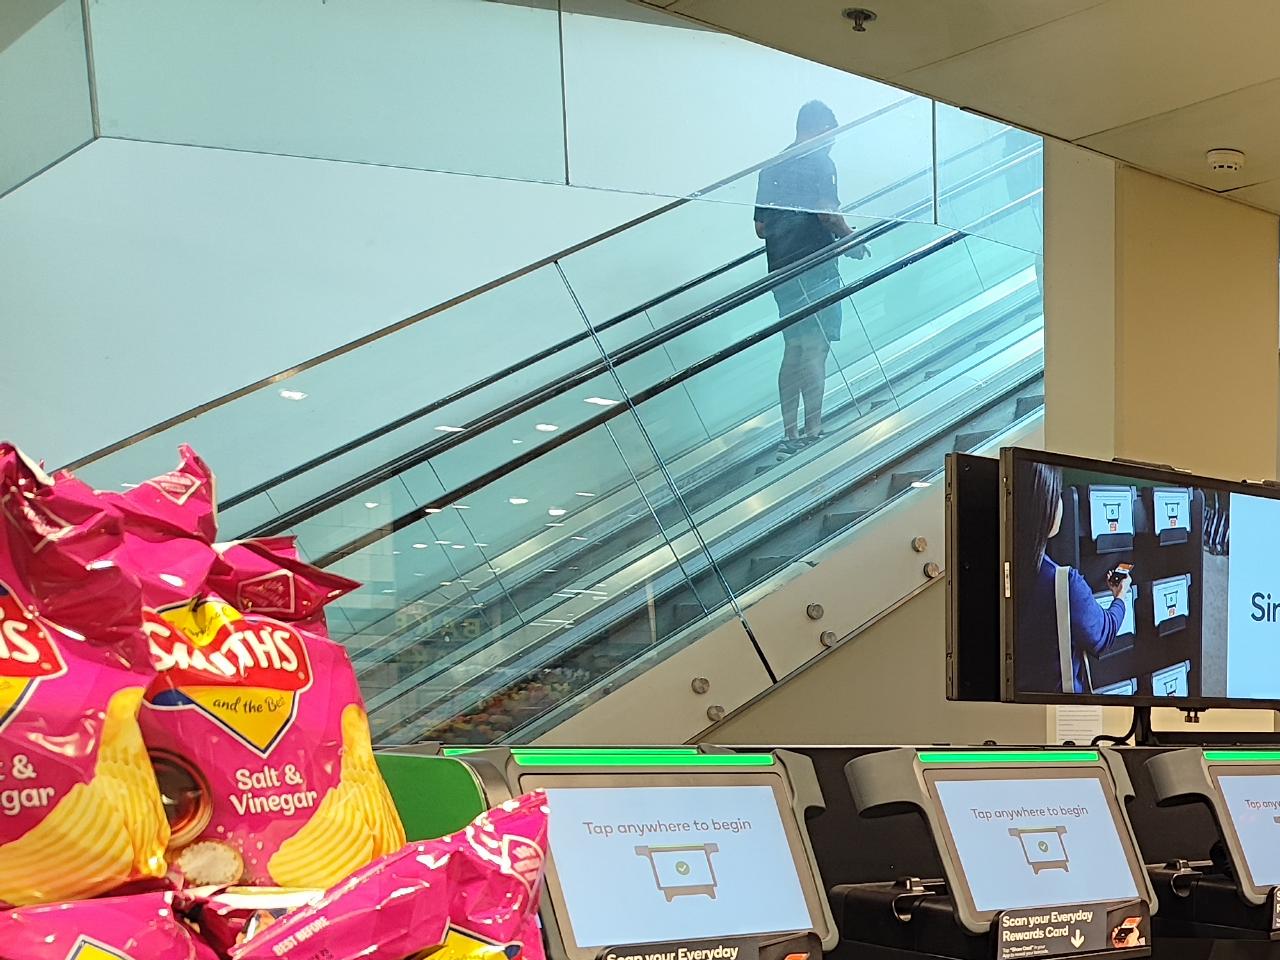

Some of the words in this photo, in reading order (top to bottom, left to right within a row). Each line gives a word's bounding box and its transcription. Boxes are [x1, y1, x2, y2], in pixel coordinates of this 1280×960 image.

[213, 697, 240, 712] and
[244, 699, 263, 714] the
[12, 754, 38, 779] &
[235, 766, 281, 790] Salt
[284, 764, 304, 785] &
[230, 790, 317, 816] Vinegar
[971, 808, 992, 822] Tap
[995, 806, 1046, 821] anywhere
[1046, 807, 1058, 816] to
[1059, 804, 1088, 818] begin
[583, 822, 613, 837] Tap
[617, 818, 690, 837] anywhere
[694, 820, 709, 832] to
[711, 818, 752, 834] begin
[1002, 915, 1028, 928] Scan
[1028, 914, 1050, 928] your
[1051, 910, 1093, 924] Everyday
[272, 936, 298, 956] BEST
[294, 916, 330, 942] BEFORE
[1002, 929, 1044, 942] Rewards
[1046, 926, 1068, 938] Card
